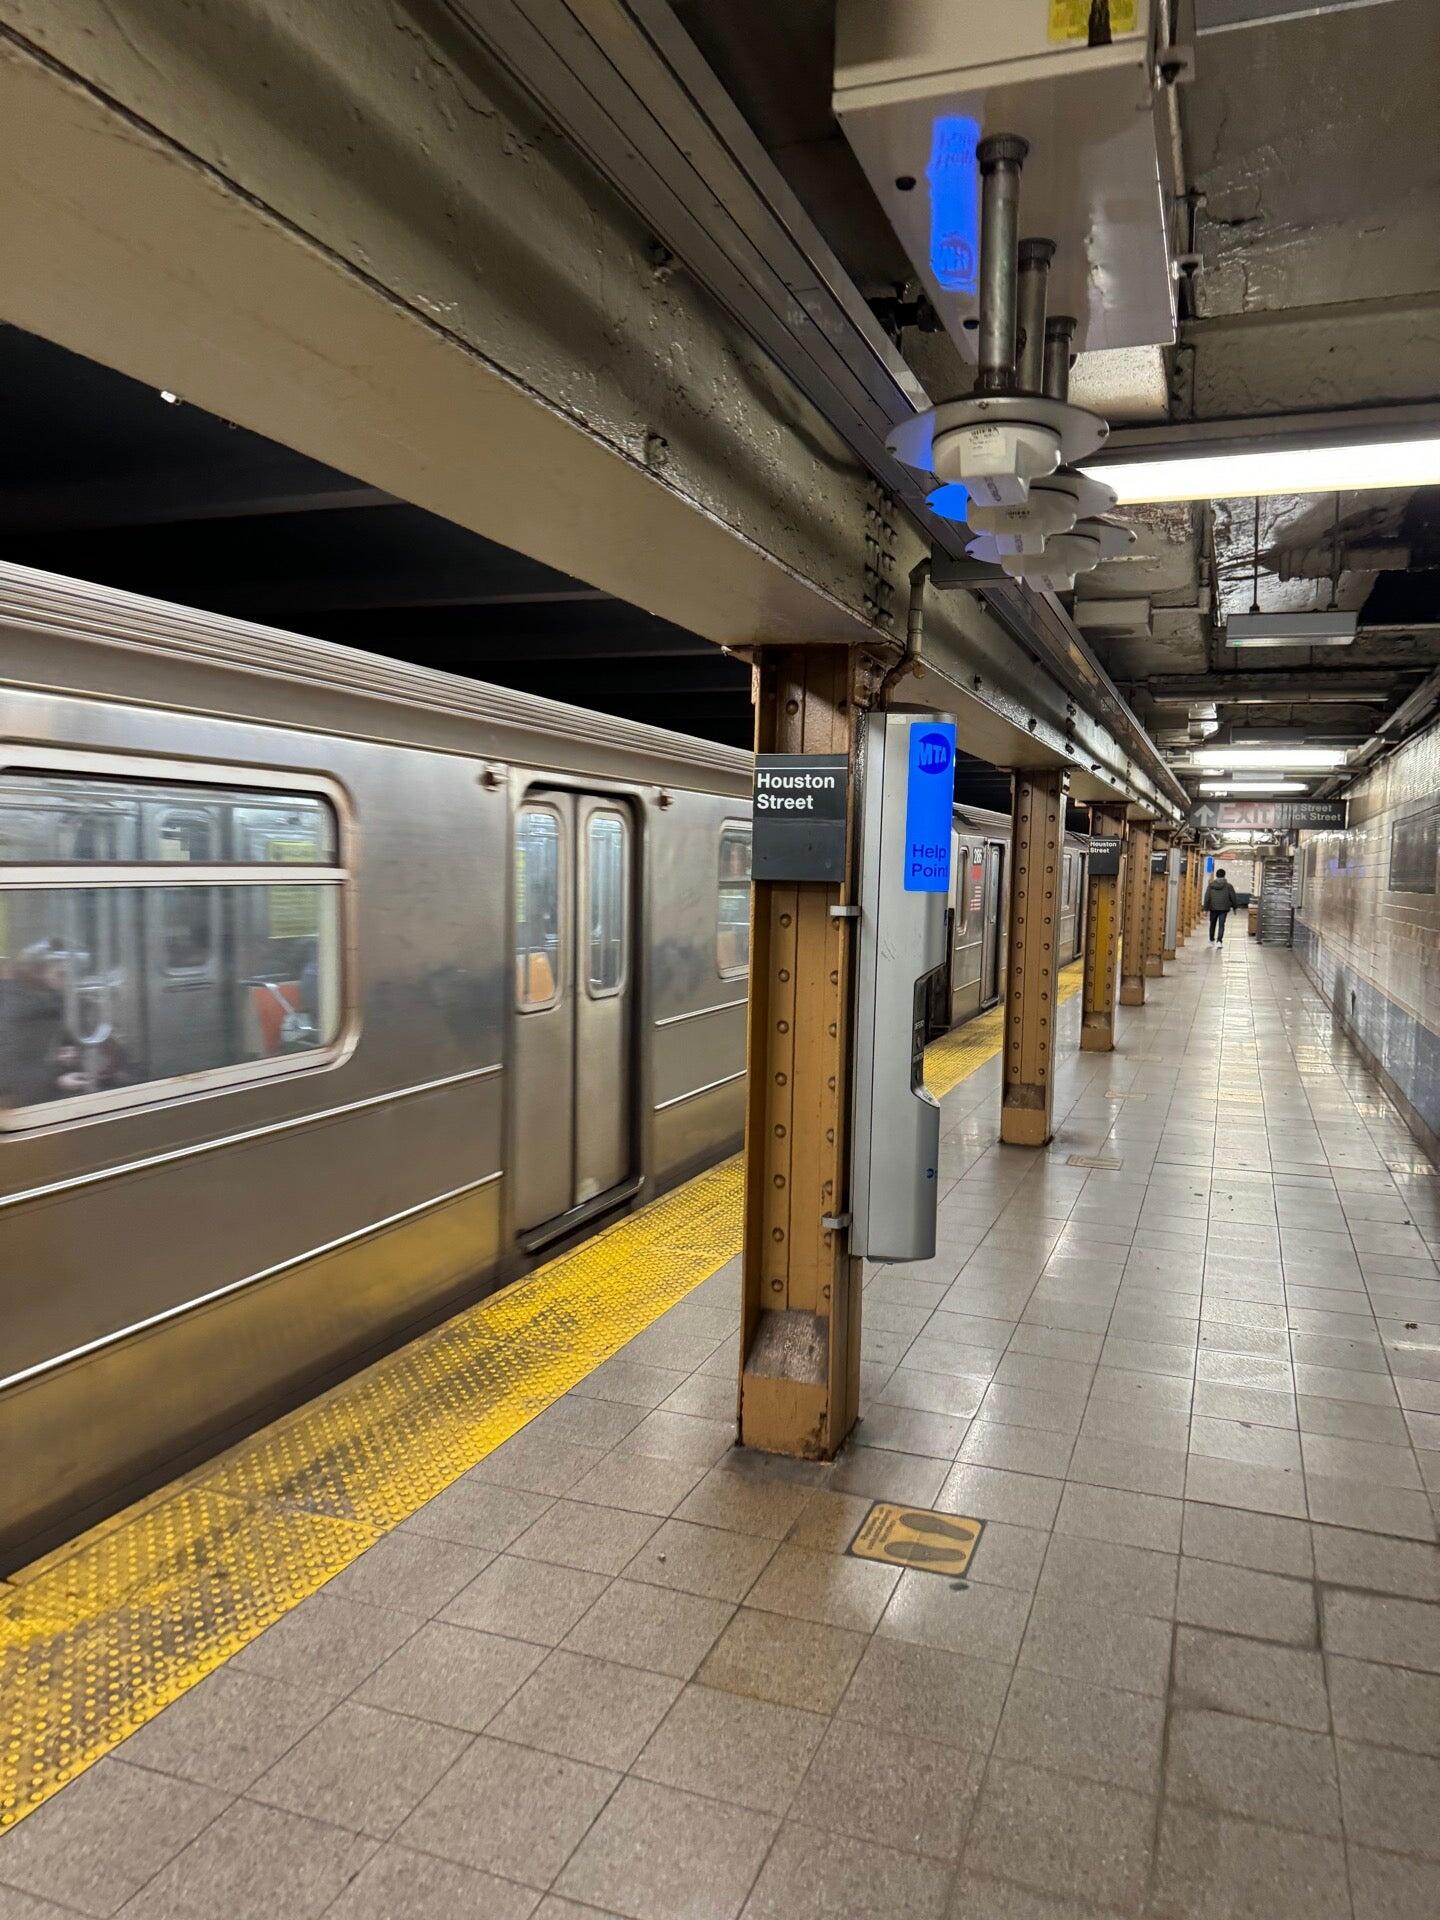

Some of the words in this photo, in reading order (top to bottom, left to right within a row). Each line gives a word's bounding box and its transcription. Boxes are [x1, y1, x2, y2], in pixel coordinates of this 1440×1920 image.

[919, 742, 947, 766] MTA
[757, 773, 835, 789] Houston
[757, 793, 814, 810] Street
[1300, 803, 1332, 812] Street
[1309, 812, 1341, 821] Street
[912, 843, 947, 861] Help
